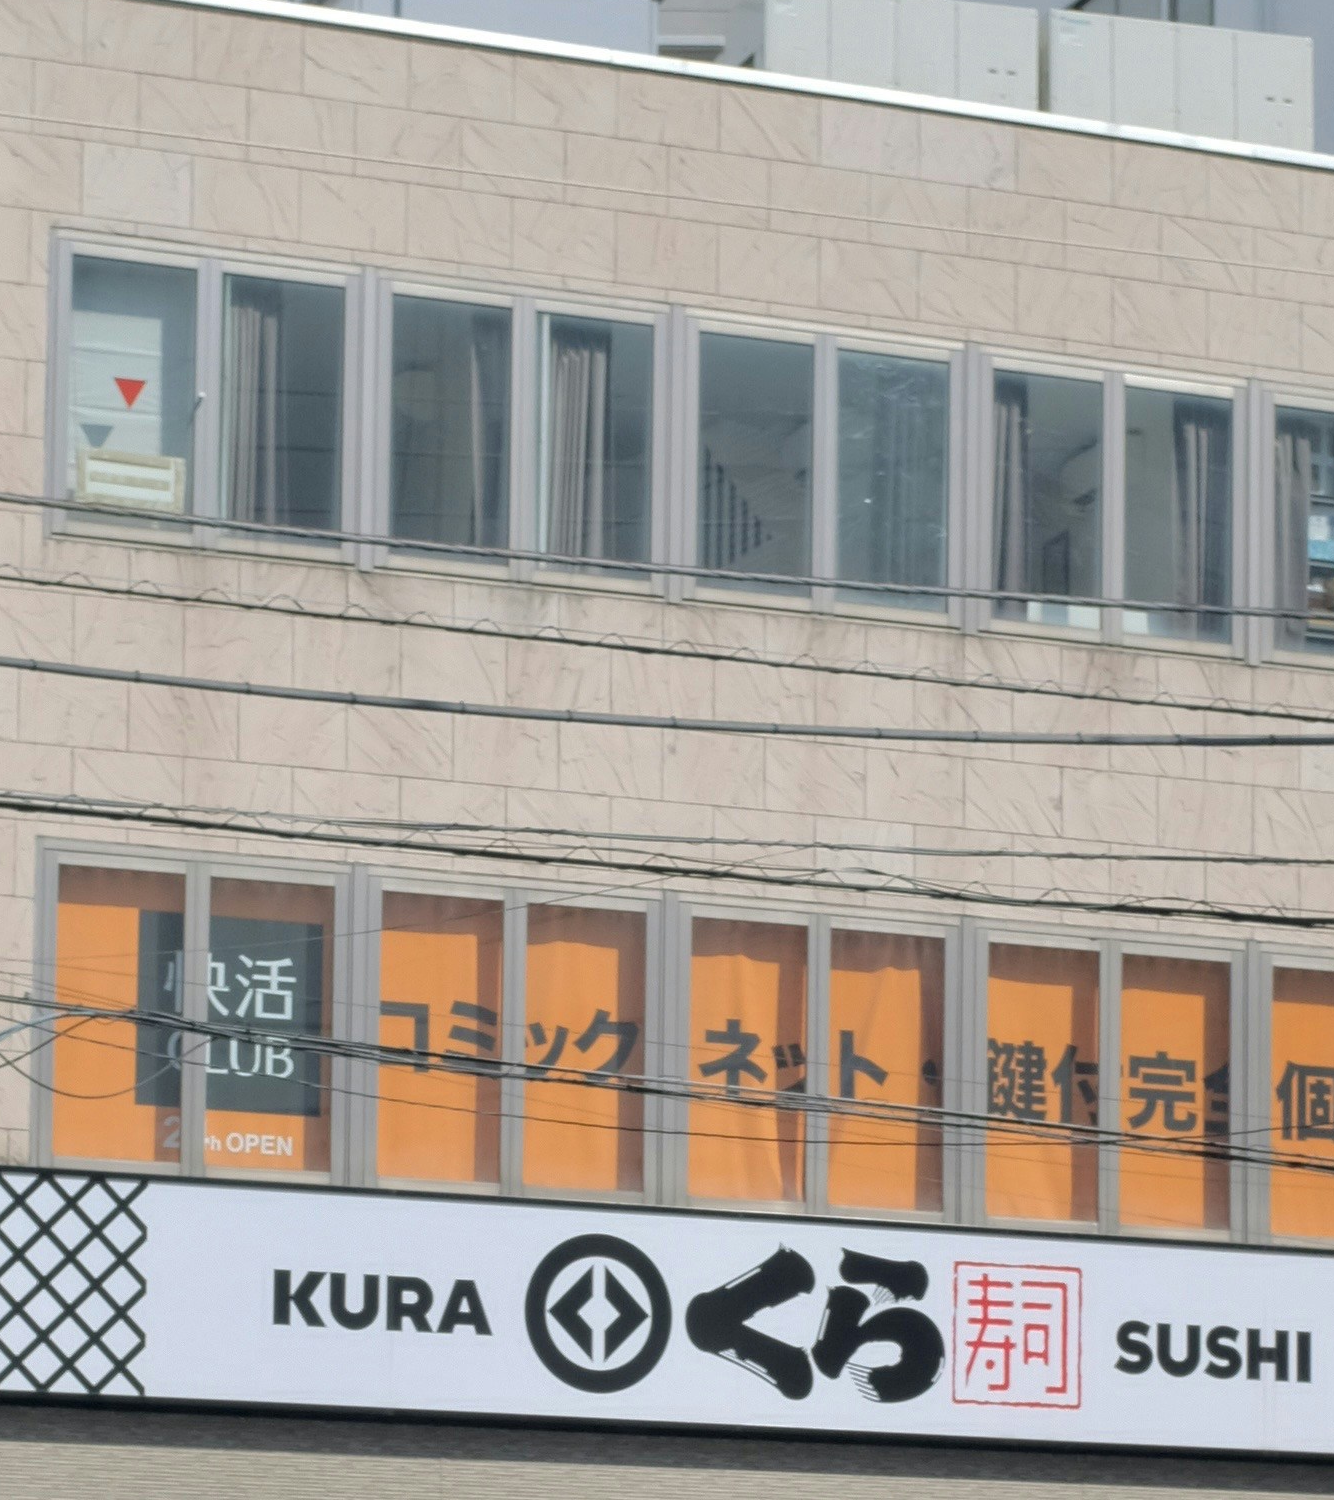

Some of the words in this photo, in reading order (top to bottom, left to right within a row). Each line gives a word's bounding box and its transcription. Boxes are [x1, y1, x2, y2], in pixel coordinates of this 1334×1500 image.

[225, 1131, 294, 1157] OPEN
[271, 1268, 493, 1337] KURA
[685, 1241, 946, 1404] くら
[1115, 1319, 1313, 1384] SUSHI
